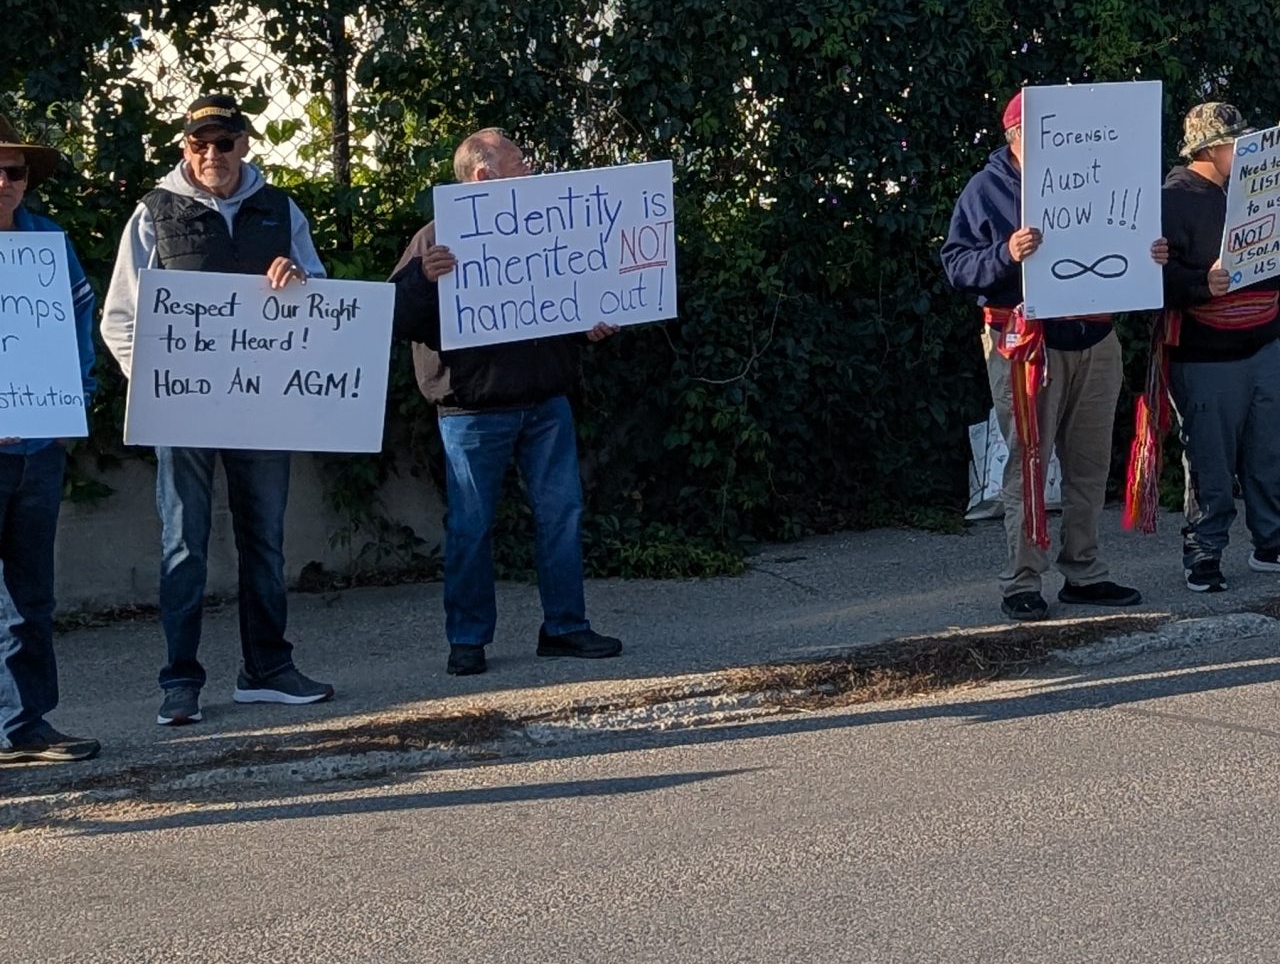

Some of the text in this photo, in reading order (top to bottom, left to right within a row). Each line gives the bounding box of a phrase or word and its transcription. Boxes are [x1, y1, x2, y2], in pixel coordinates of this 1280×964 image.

[1240, 158, 1267, 181] Need
[454, 184, 667, 244] Identity is
[1247, 200, 1260, 216] to
[1232, 220, 1272, 250] NOT
[455, 220, 673, 290] inherited NOT
[153, 287, 361, 331] Respect Our Right
[456, 267, 664, 334] handed out!
[159, 324, 186, 353] to
[194, 330, 217, 352] be
[283, 367, 361, 399] AGM!
